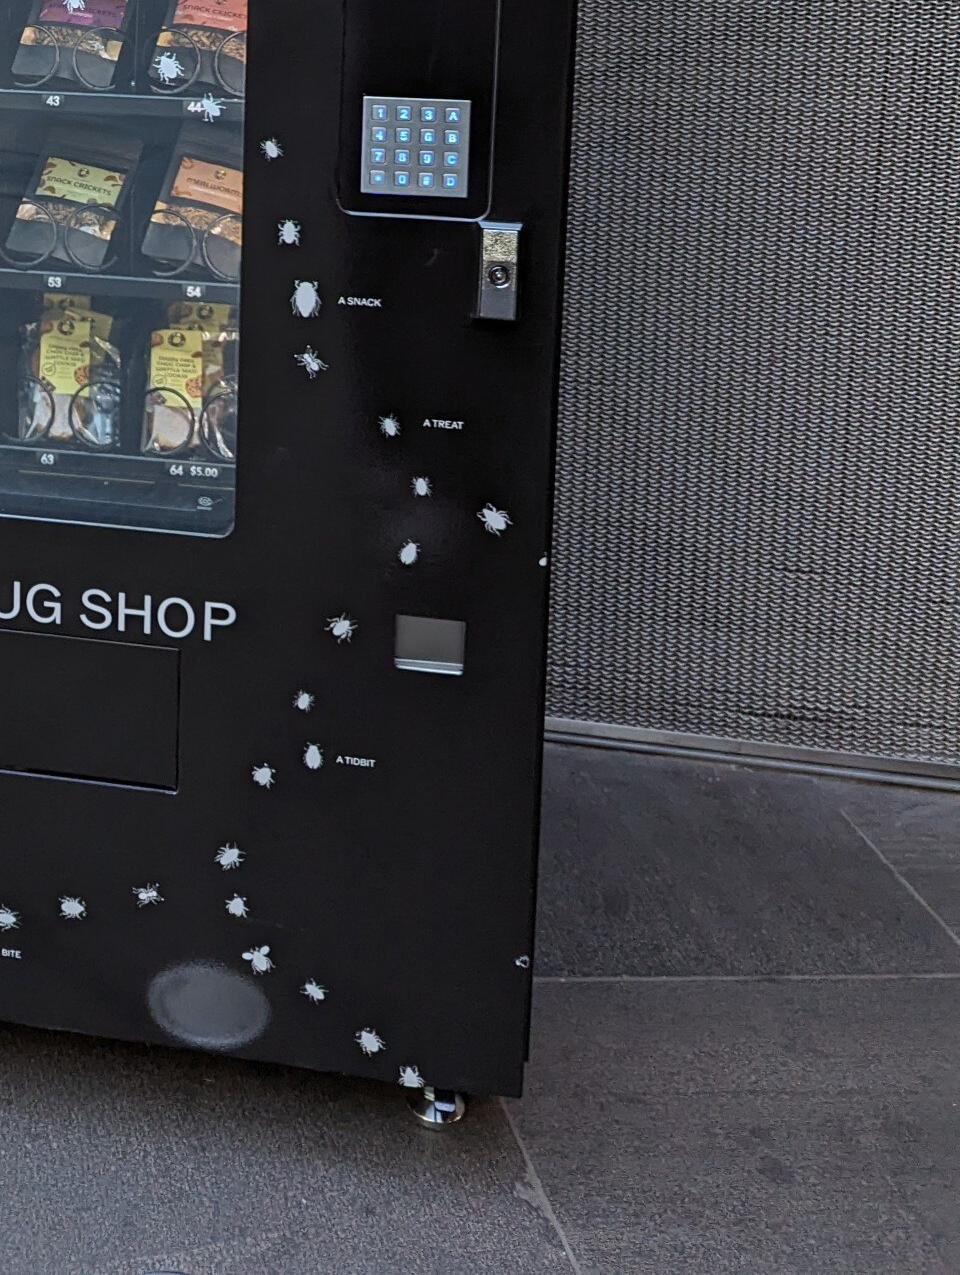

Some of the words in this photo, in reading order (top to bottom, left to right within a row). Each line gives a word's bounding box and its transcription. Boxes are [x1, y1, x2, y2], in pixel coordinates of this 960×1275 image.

[182, 4, 212, 13] SNACK
[46, 95, 60, 106] 43
[377, 108, 384, 118] 1
[400, 109, 409, 120] 2
[424, 110, 434, 121] 3
[448, 111, 458, 121] A
[375, 131, 384, 141] 4
[399, 131, 409, 141] 5
[424, 132, 433, 142] 6
[448, 133, 457, 143] B
[374, 151, 383, 161] 7
[398, 153, 407, 162] 8
[423, 154, 431, 163] 9
[447, 155, 456, 165] C
[46, 176, 72, 186] SNACK
[73, 181, 112, 196] CRICKETS
[398, 174, 406, 184] 0
[446, 177, 455, 187] D
[47, 276, 62, 288] 53
[186, 286, 202, 298] 54
[338, 296, 346, 305] A
[346, 297, 382, 307] SNACK
[422, 419, 431, 427] A
[431, 419, 464, 430] TREAT
[40, 454, 55, 465] 63
[169, 465, 184, 476] 64
[190, 466, 218, 478] $5.00
[79, 588, 237, 641] SHOP
[336, 755, 344, 764] A
[344, 756, 376, 768] TIDBIT
[1, 948, 22, 959] BITE
